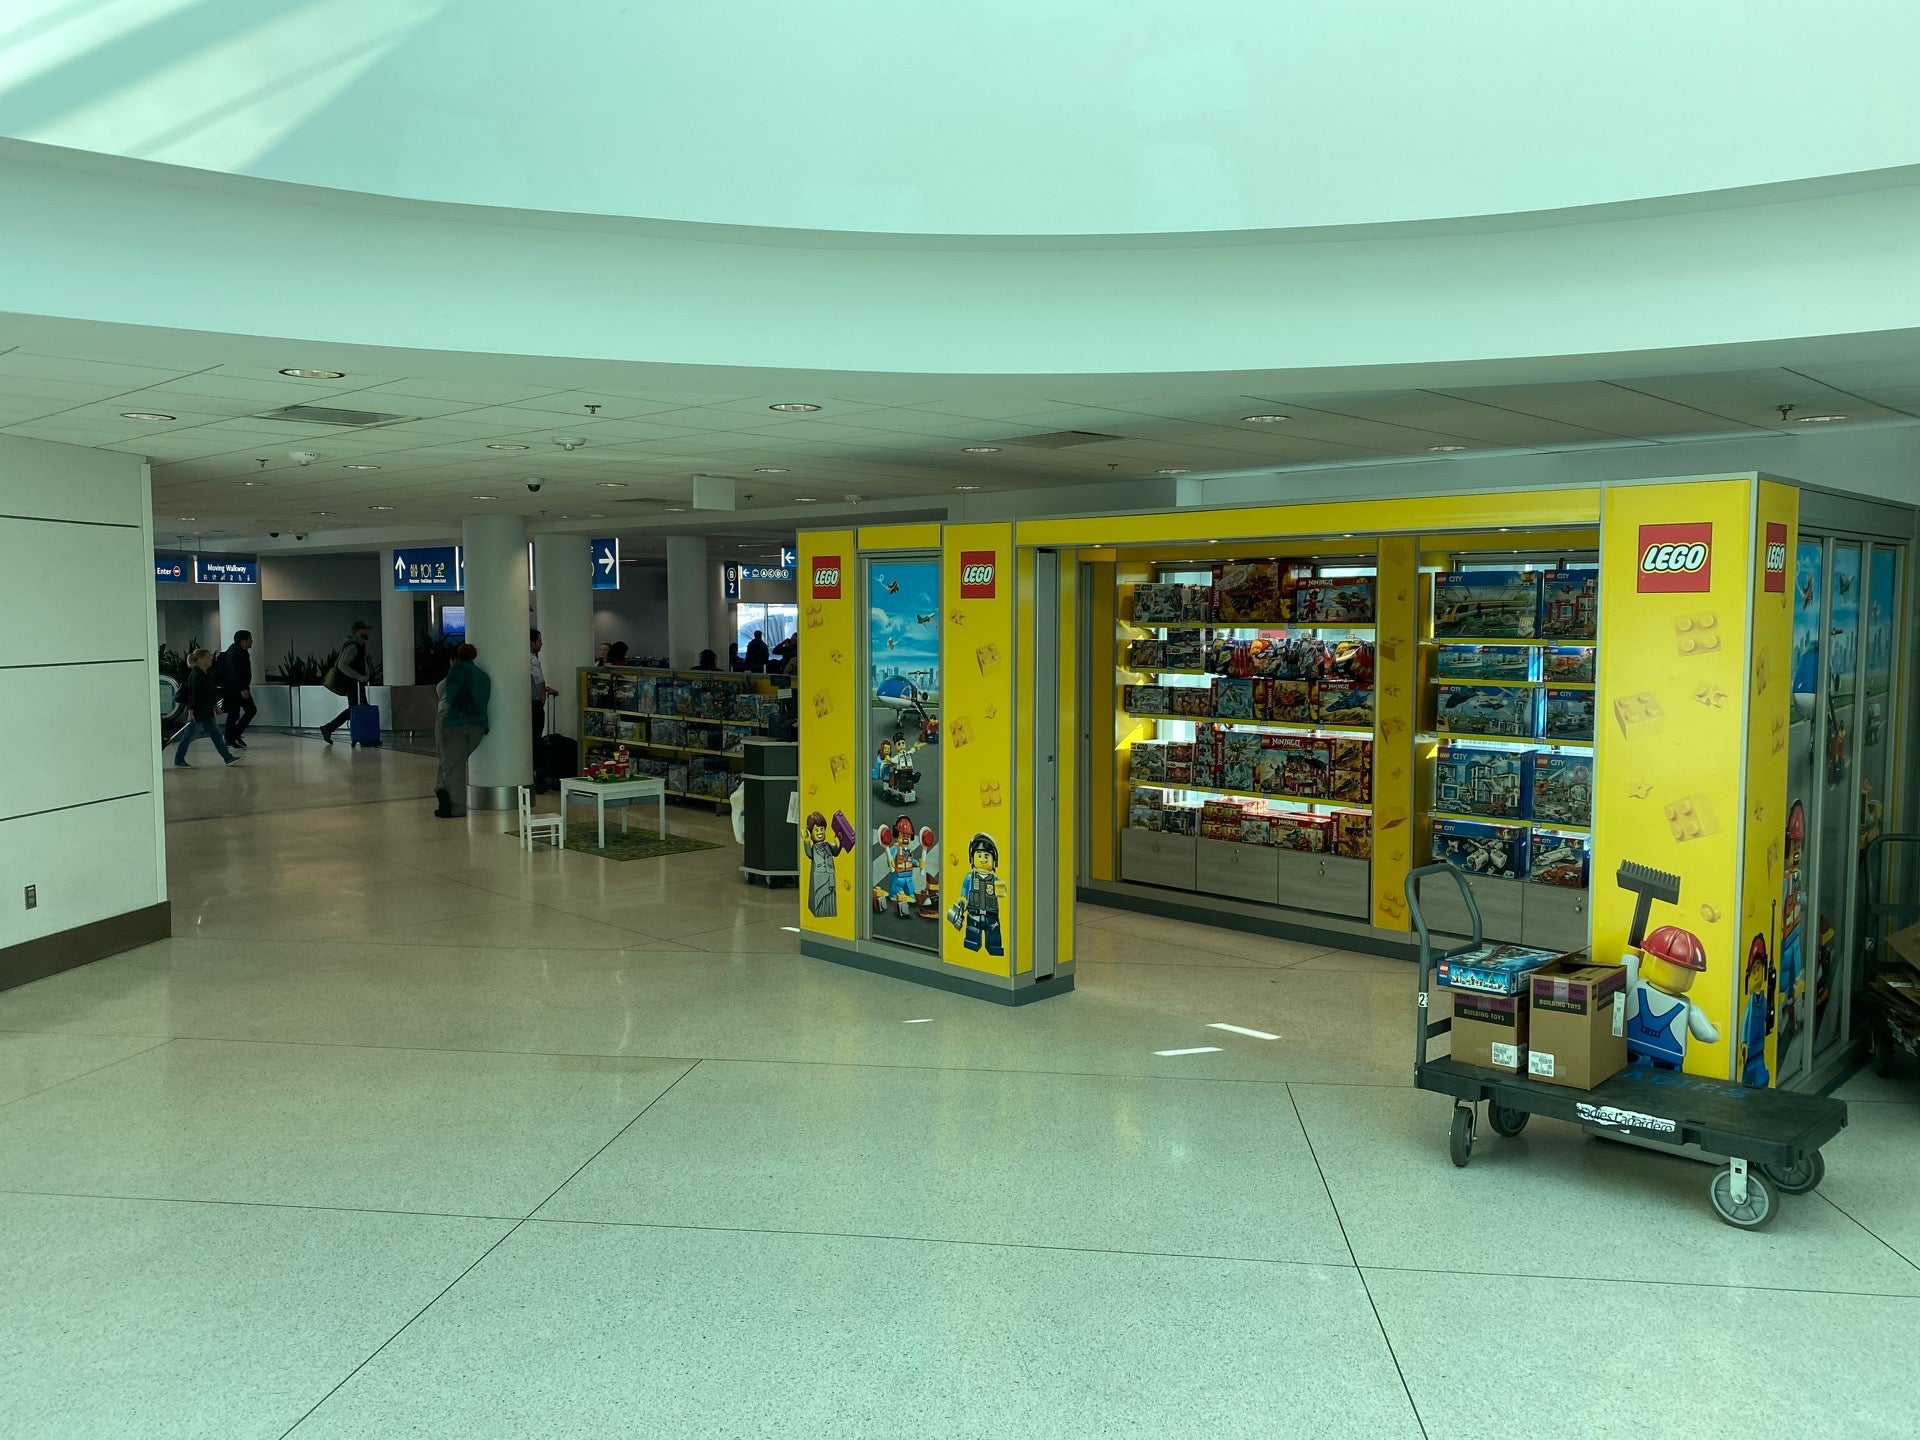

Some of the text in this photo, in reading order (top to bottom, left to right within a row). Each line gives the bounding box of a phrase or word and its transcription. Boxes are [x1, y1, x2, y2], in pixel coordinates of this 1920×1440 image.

[1641, 543, 1707, 572] LEGO
[1767, 543, 1784, 571] LEGO
[157, 567, 172, 575] Enter
[207, 564, 247, 574] Moving Walkway
[814, 569, 839, 586] LEGO
[963, 565, 993, 585] LEGO
[729, 583, 735, 594] 2
[1271, 738, 1301, 747] NINJAGO
[1550, 759, 1565, 767] CITY
[1539, 999, 1566, 1008] BUILDING
[1463, 1008, 1505, 1021] BUILDING TOYS
